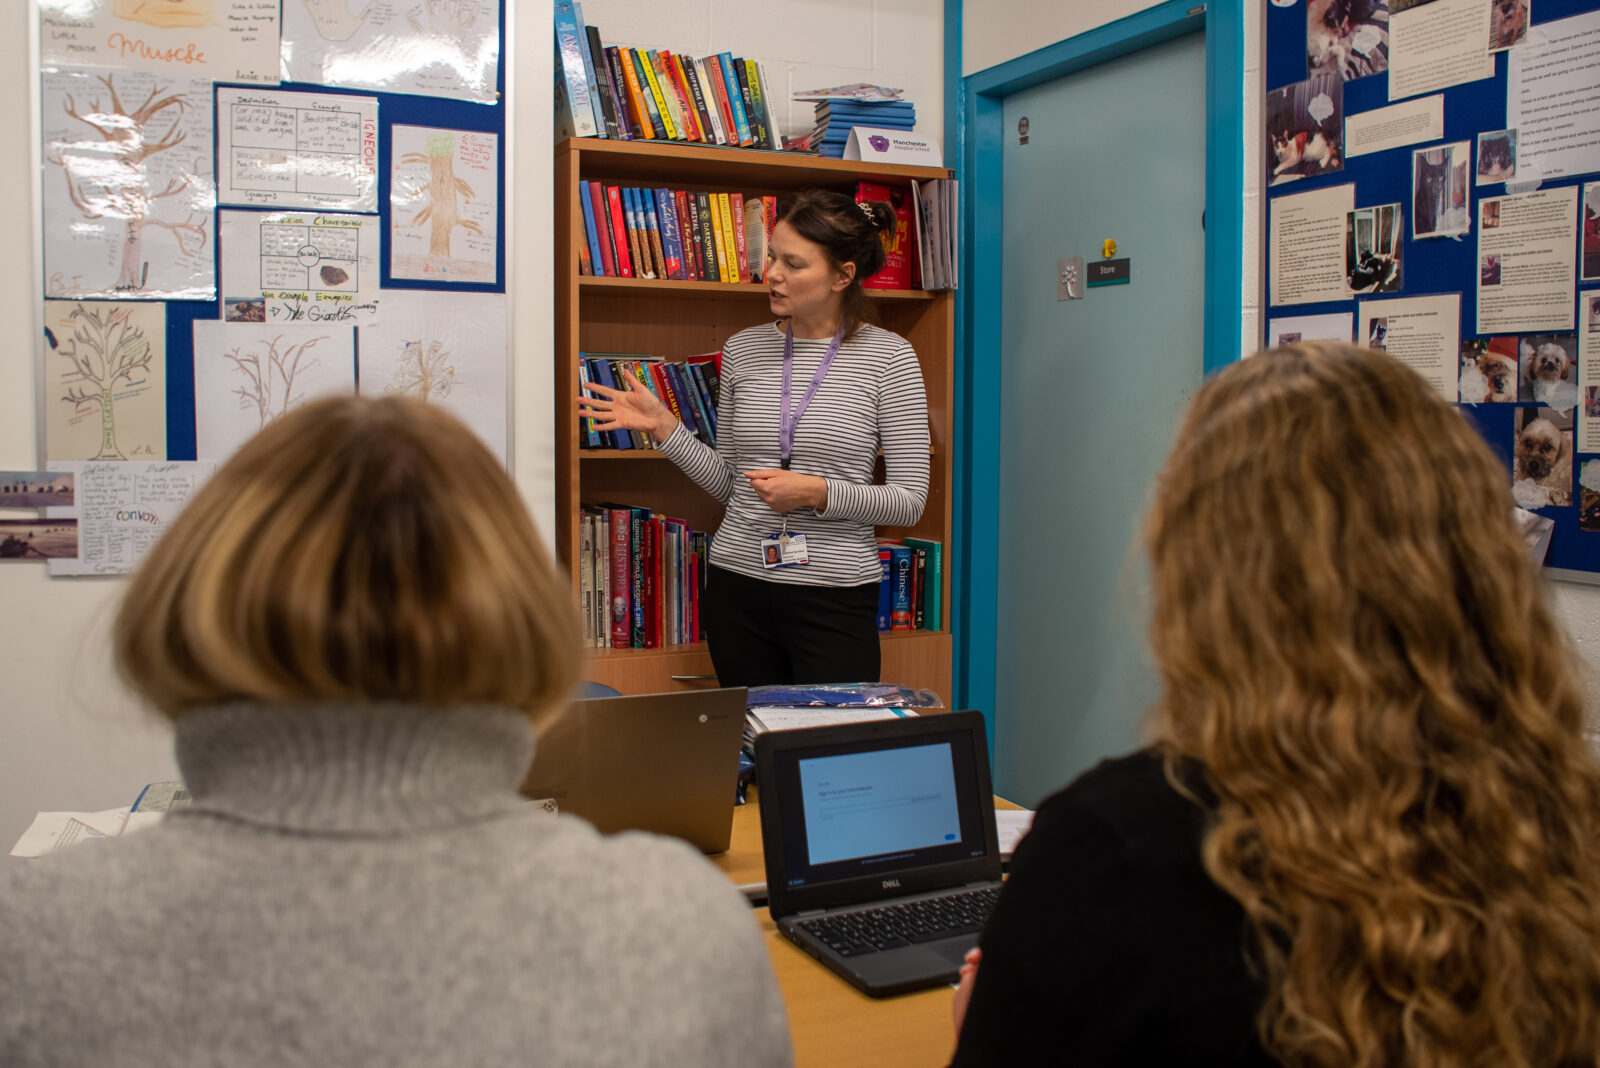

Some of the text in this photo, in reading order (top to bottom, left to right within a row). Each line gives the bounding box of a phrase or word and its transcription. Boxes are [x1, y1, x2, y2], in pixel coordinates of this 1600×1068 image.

[108, 32, 207, 63] Muscle
[664, 55, 679, 90] PUNCHING
[689, 71, 702, 101] SUPREME
[893, 139, 927, 147] Manchester
[691, 202, 699, 231] ARRIVAL
[1100, 265, 1115, 275] Store
[618, 544, 626, 593] HISTORY
[899, 559, 910, 602] Chinese
[882, 879, 901, 889] DELL
